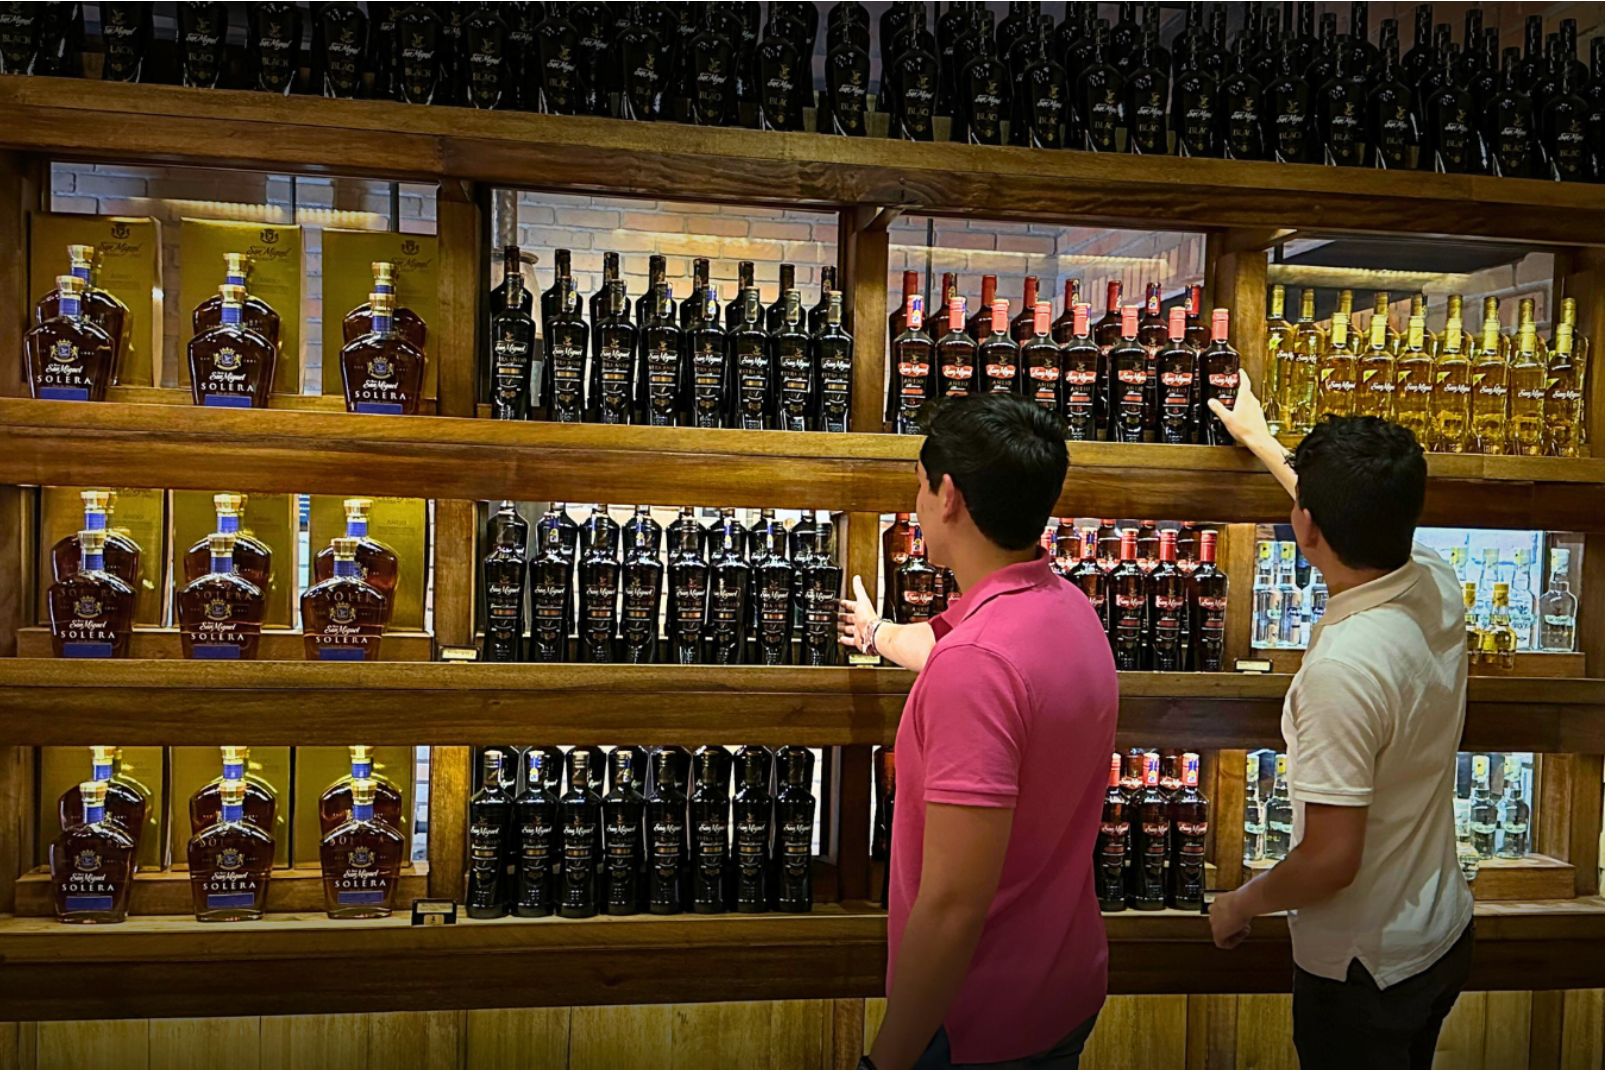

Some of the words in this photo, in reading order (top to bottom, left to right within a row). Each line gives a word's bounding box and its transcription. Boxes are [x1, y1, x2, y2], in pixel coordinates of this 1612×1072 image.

[2, 34, 31, 44] BLACK
[262, 57, 289, 67] BLACK
[37, 375, 93, 386] SOLERA
[201, 383, 254, 393] SOLERA
[354, 390, 406, 400] SOLERA
[70, 619, 84, 630] San
[84, 620, 107, 631] Miguel
[199, 622, 214, 632] San
[214, 622, 237, 633] Miguel
[60, 630, 116, 640] SOLERA
[324, 625, 338, 635] San
[338, 626, 360, 636] Miguel
[191, 633, 244, 641] SOLERA
[316, 636, 368, 644] SOLERA
[212, 872, 226, 880] San
[226, 872, 248, 881] Miguel
[343, 870, 358, 879] San
[358, 870, 379, 880] Miguel
[62, 884, 115, 892] SOLERA
[202, 882, 256, 890] SOLERA
[334, 880, 386, 888] SOLERA
